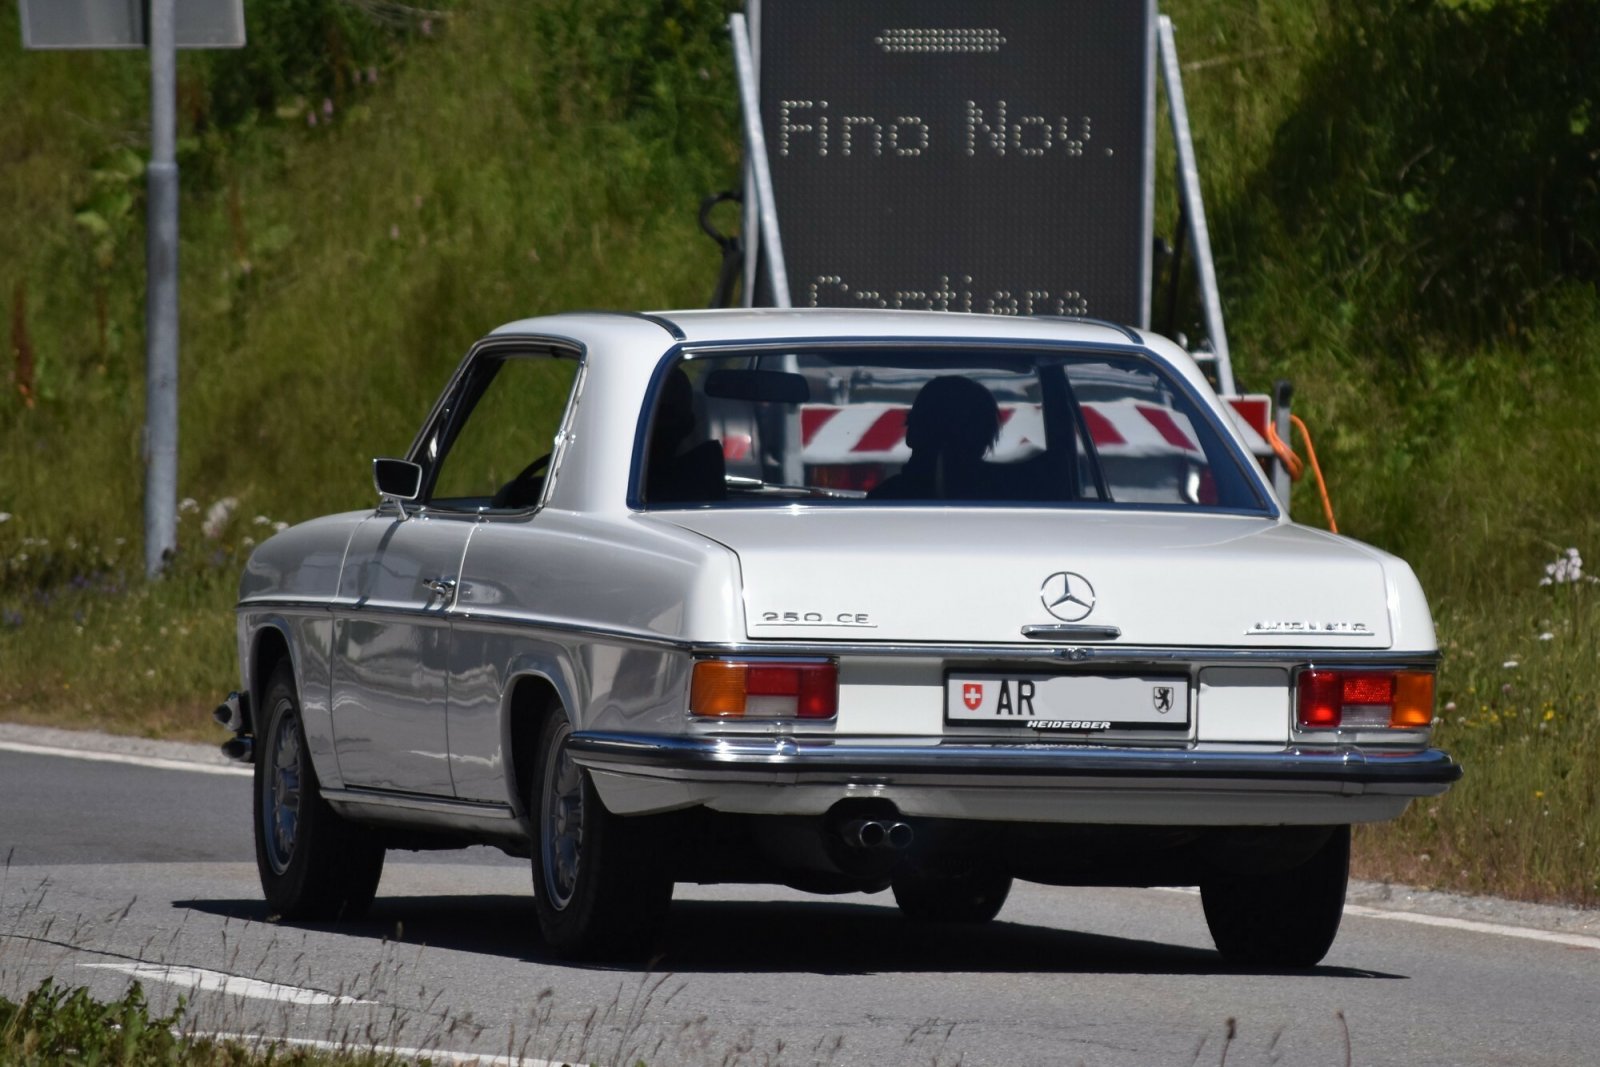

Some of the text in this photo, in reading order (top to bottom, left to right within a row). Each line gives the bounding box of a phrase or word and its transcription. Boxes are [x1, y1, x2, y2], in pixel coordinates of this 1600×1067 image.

[779, 100, 1114, 157] Fino Nov.
[762, 611, 869, 624] 250 CE
[996, 678, 1035, 716] AR
[1026, 720, 1111, 730] HEIDEGGER
